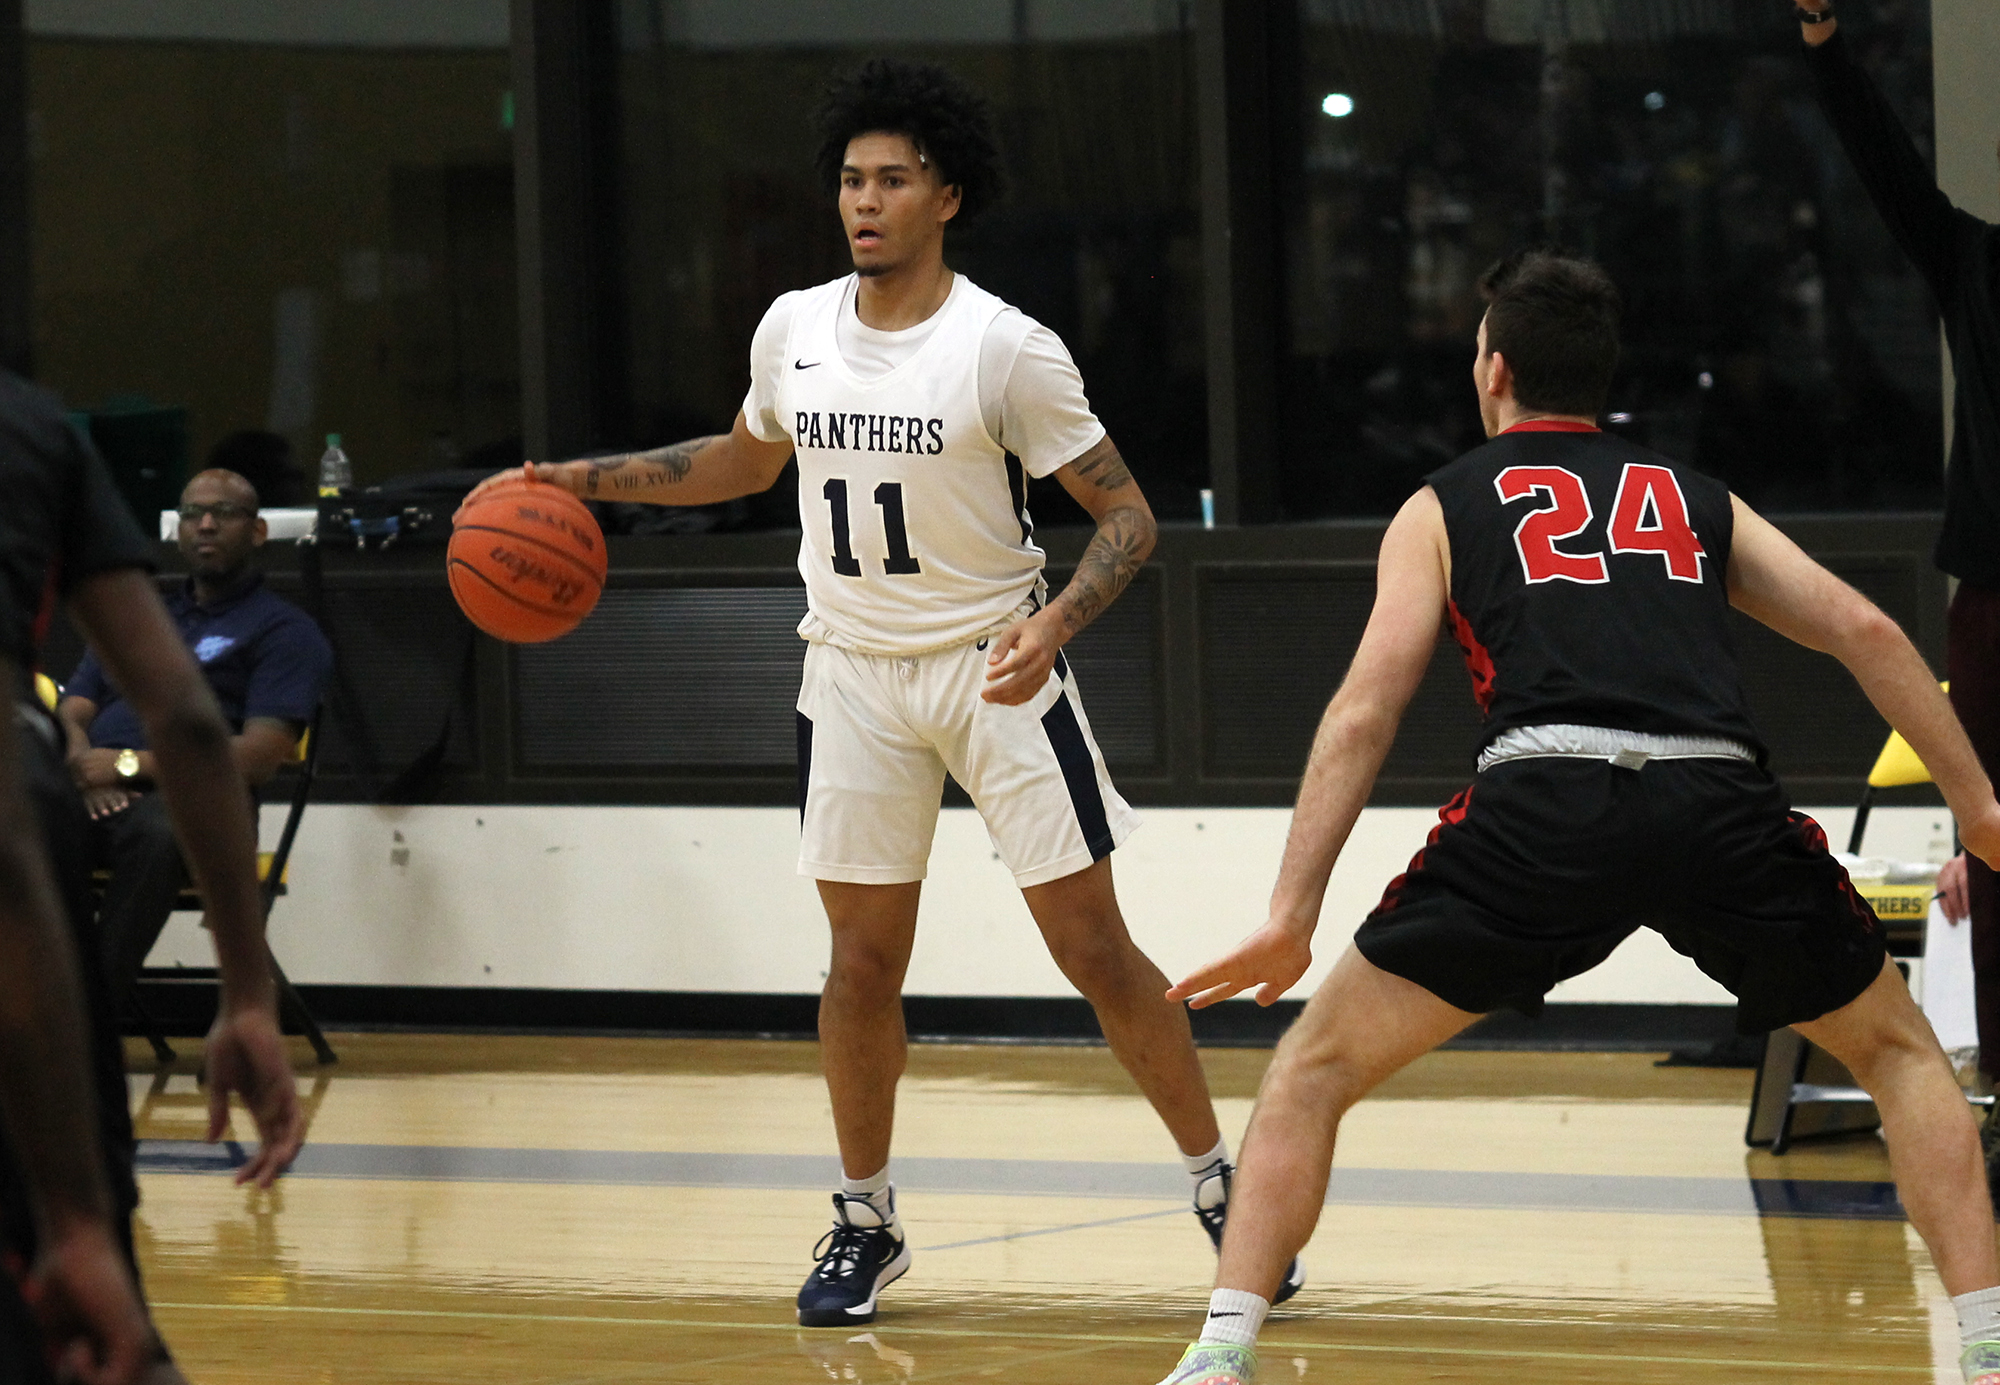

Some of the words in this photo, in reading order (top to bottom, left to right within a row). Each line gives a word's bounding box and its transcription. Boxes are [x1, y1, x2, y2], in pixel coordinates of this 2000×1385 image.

[796, 411, 944, 455] PANTHERS
[823, 478, 921, 577] 11
[1493, 463, 1708, 585] 24
